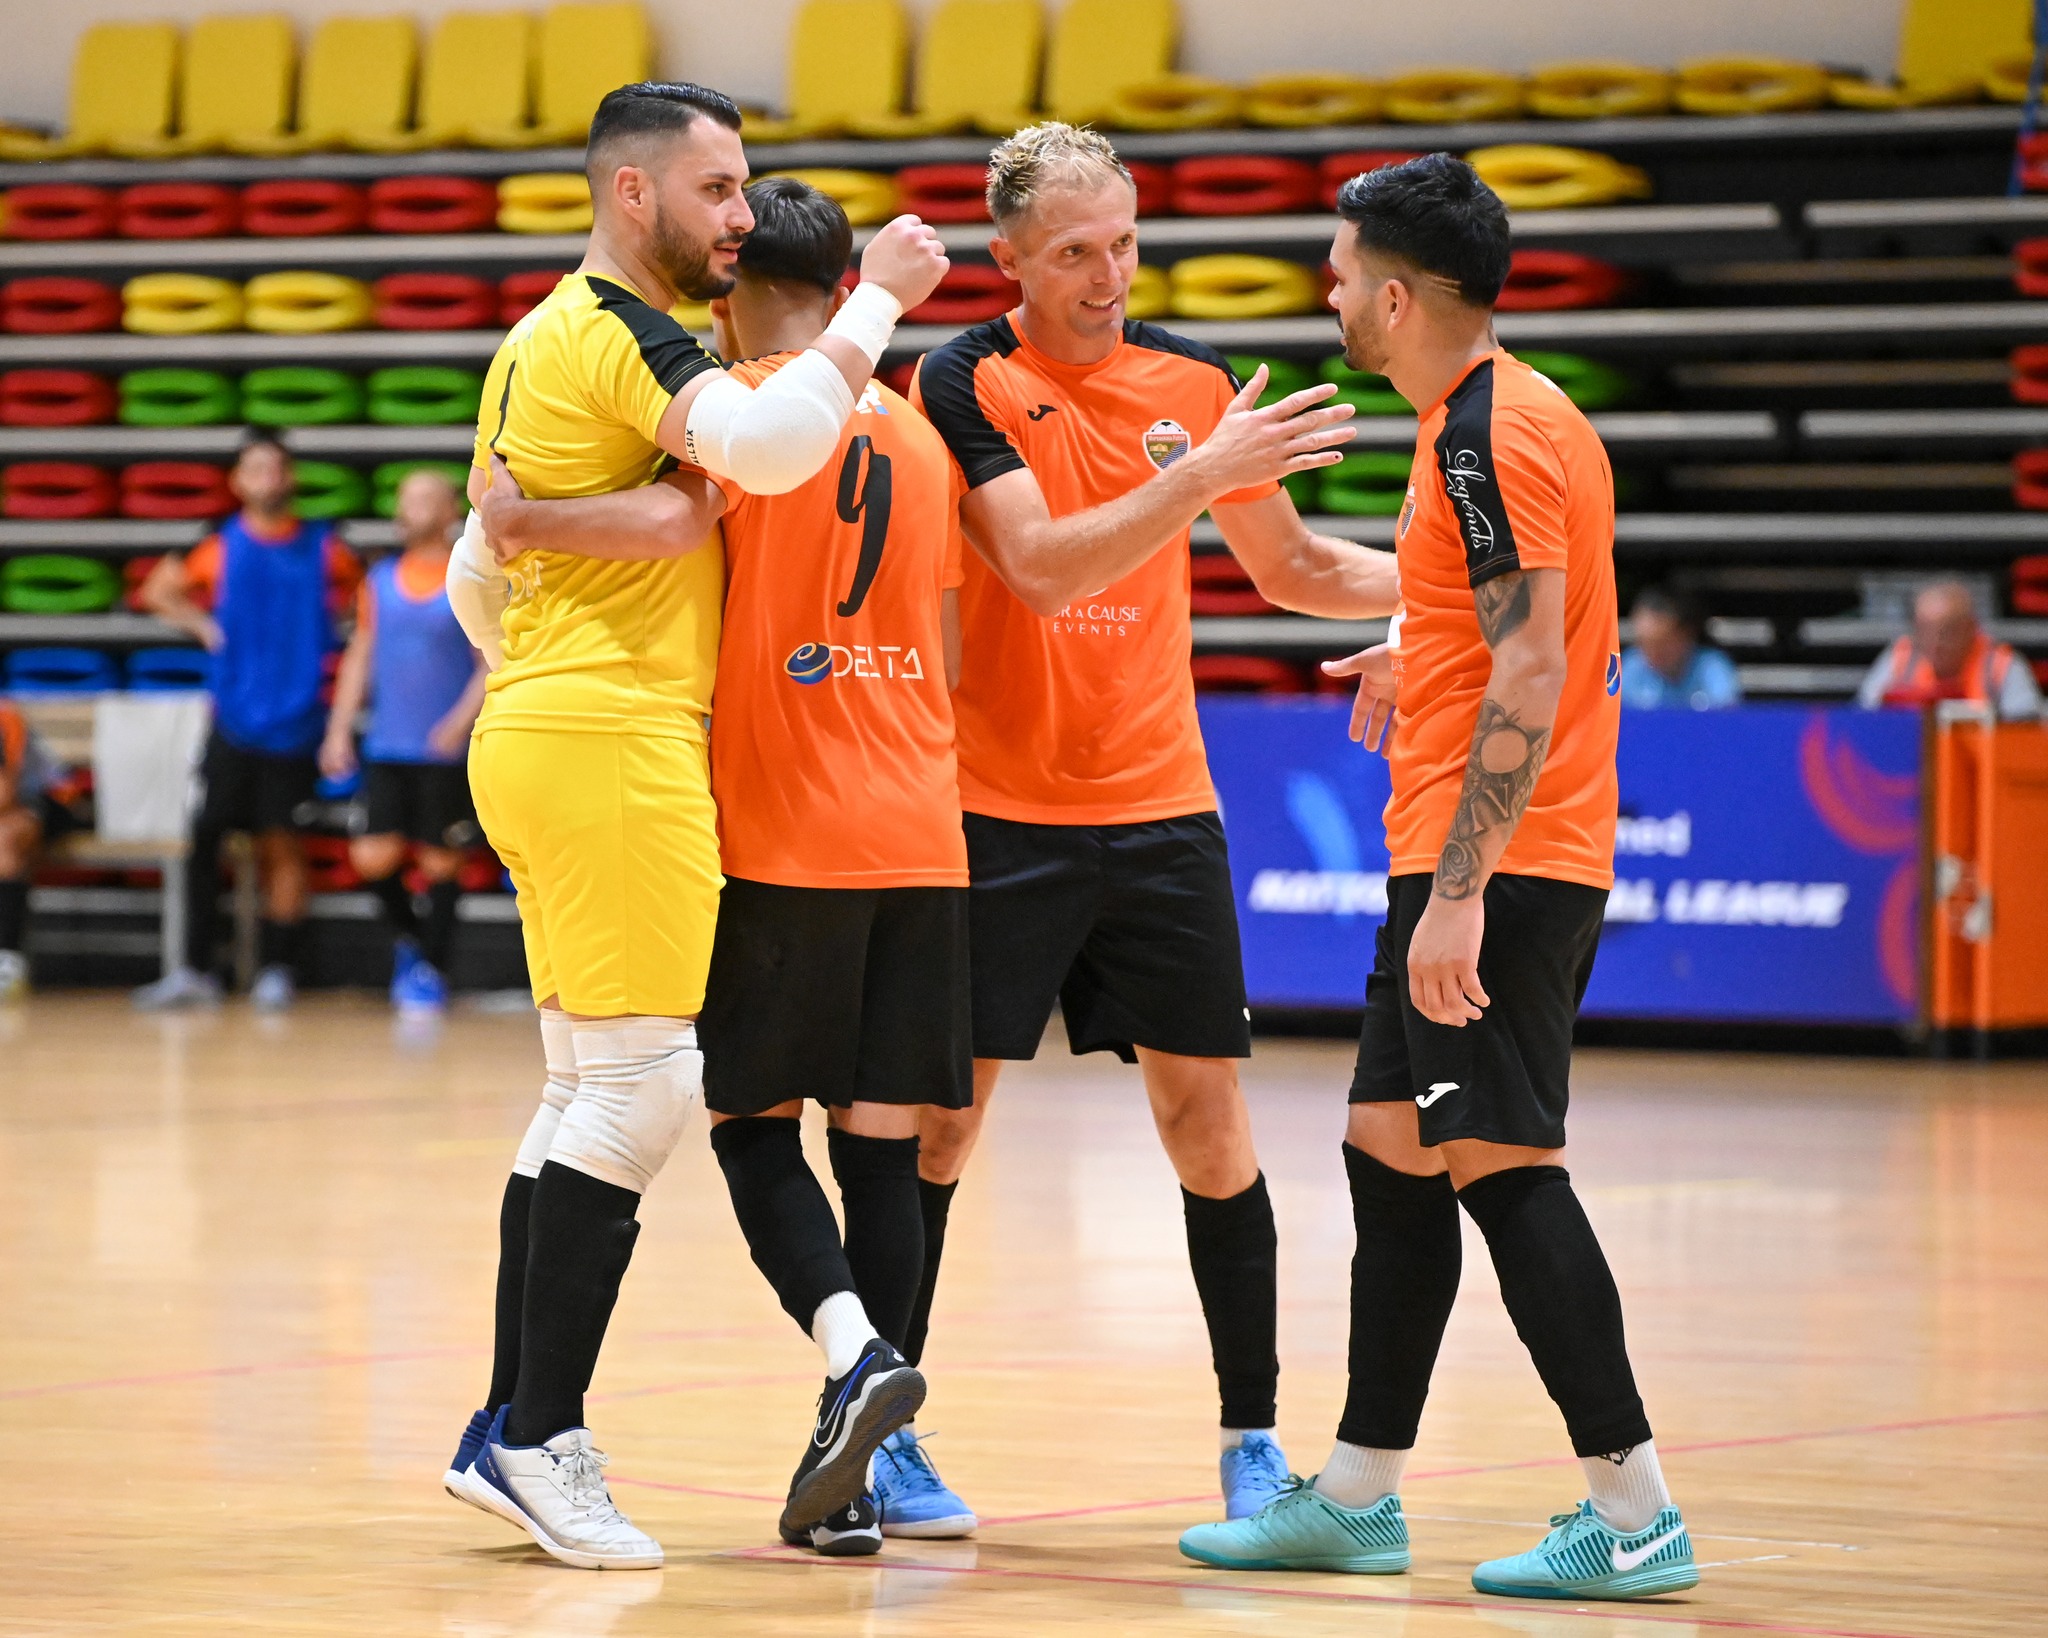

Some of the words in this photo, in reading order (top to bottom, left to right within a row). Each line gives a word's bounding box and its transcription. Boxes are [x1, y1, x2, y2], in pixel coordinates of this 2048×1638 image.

[1445, 447, 1494, 553] Legends
[836, 435, 892, 617] 9
[1053, 621, 1126, 637] EVENTS
[1087, 604, 1141, 622] CAUSE
[831, 645, 924, 680] DELTA
[1664, 879, 1848, 927] LEAGUE
